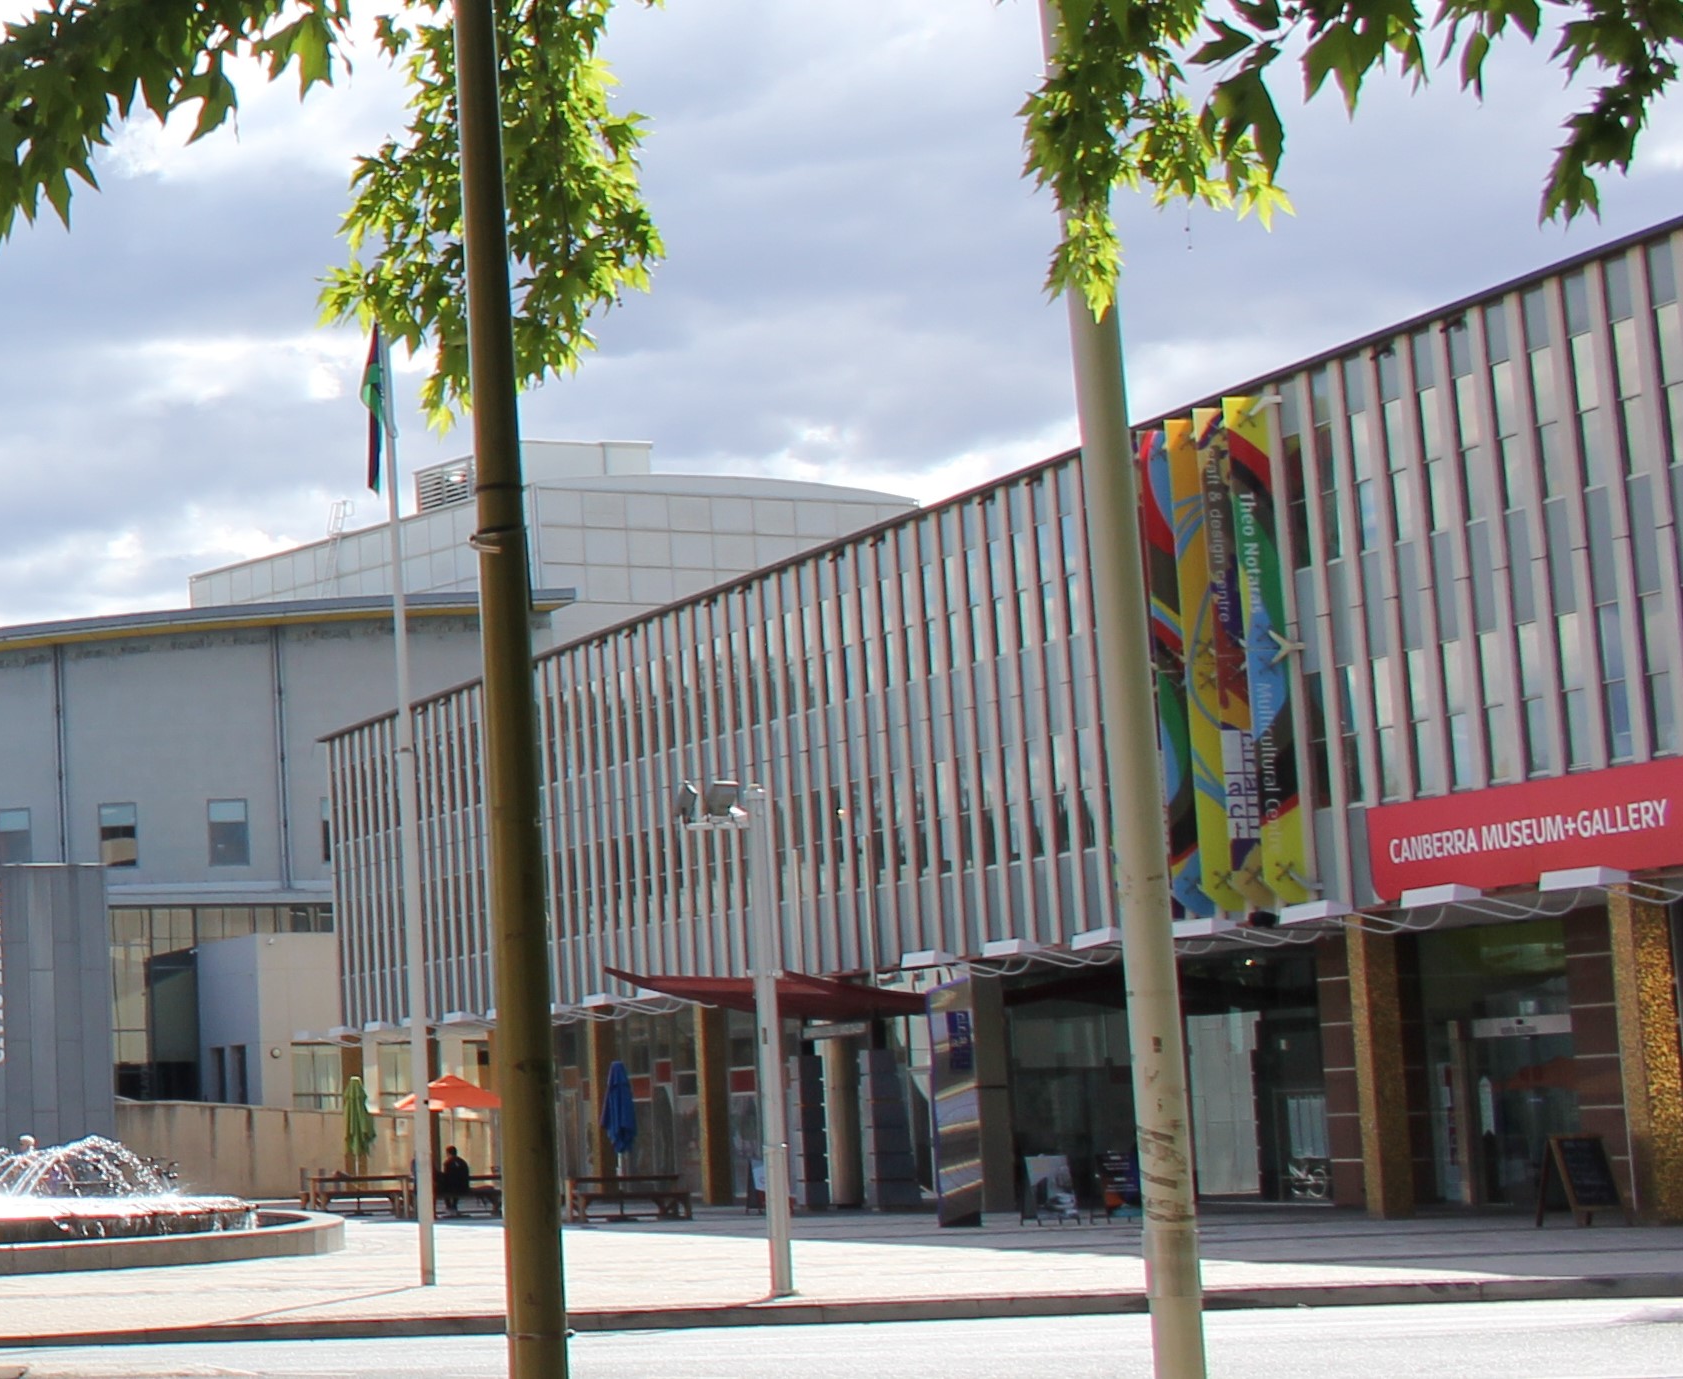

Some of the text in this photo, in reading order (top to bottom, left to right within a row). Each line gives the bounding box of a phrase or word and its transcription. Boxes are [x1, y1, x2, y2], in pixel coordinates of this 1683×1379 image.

[1210, 509, 1226, 564] design
[1239, 492, 1263, 614] Theo Notaras
[1216, 570, 1230, 622] centre
[1255, 683, 1284, 855] Multicultural Centre
[1389, 799, 1668, 864] CANBERRA MUSEUM+GALLERY
